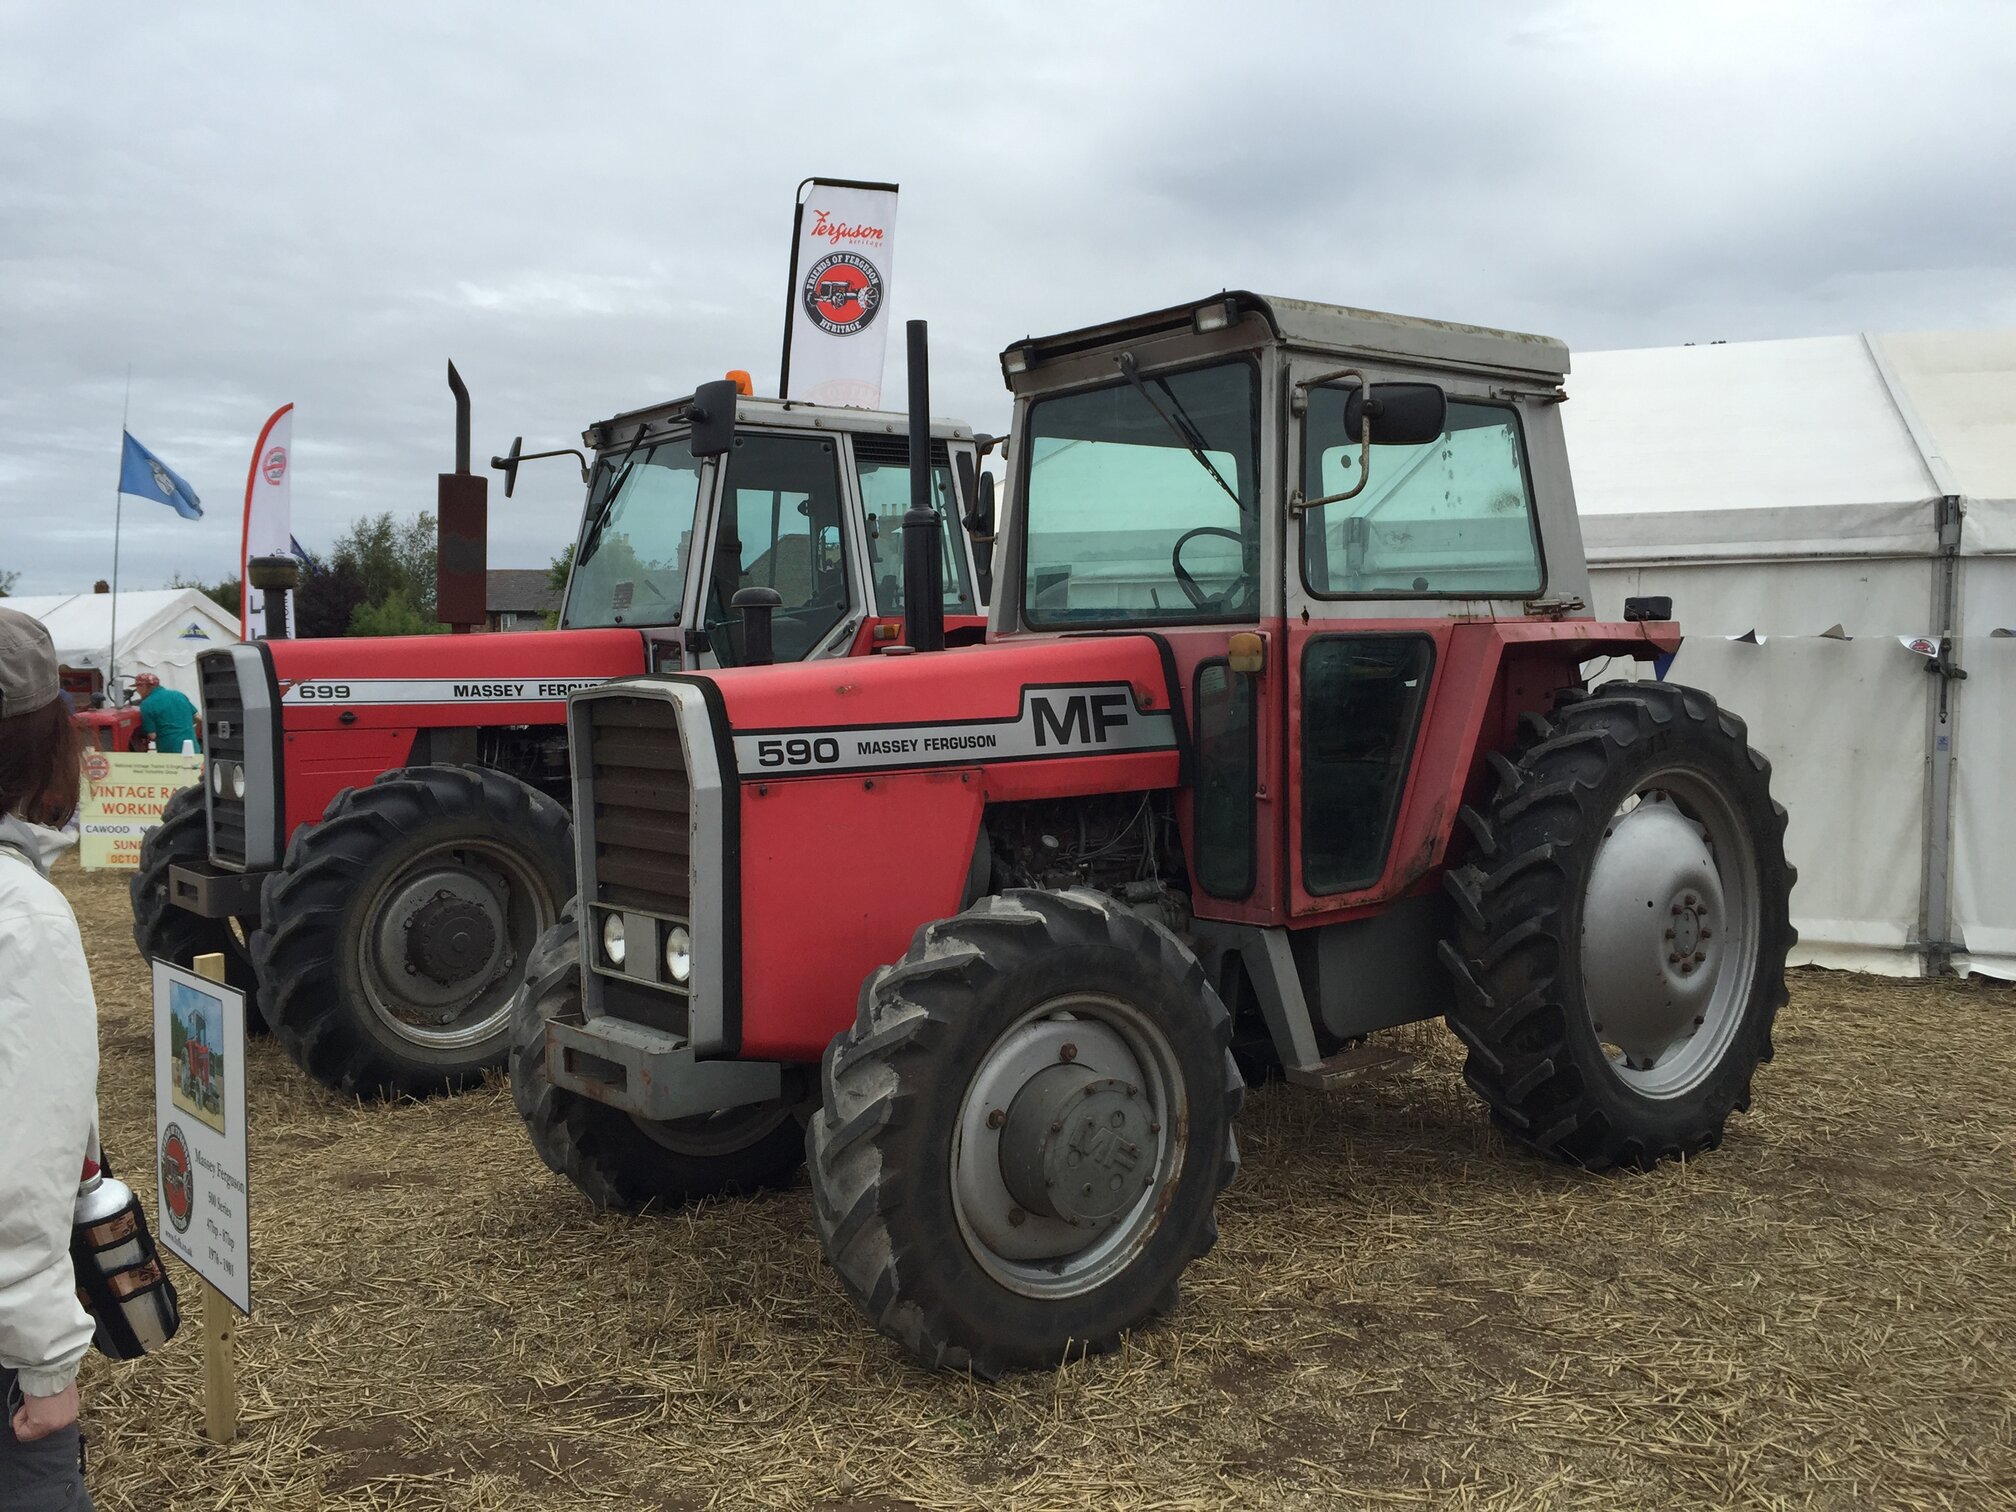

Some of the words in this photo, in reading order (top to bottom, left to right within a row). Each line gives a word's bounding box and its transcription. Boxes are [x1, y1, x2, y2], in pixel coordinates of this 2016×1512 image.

[811, 209, 884, 245] Ferguson
[806, 258, 831, 290] FRIENDS
[832, 254, 844, 264] OF
[844, 254, 880, 285] FERGUSON
[819, 318, 862, 333] HERITAGE
[299, 685, 350, 698] 699
[453, 684, 525, 697] MASSEY
[1030, 694, 1129, 746] MF
[758, 737, 840, 767] 590
[857, 738, 918, 755] MASSEY
[924, 734, 997, 752] FERGUSON
[91, 786, 156, 798] VINTAGE
[85, 825, 130, 834] CAWOOD
[195, 1147, 216, 1179] Massey
[217, 1161, 245, 1194] Ferguson
